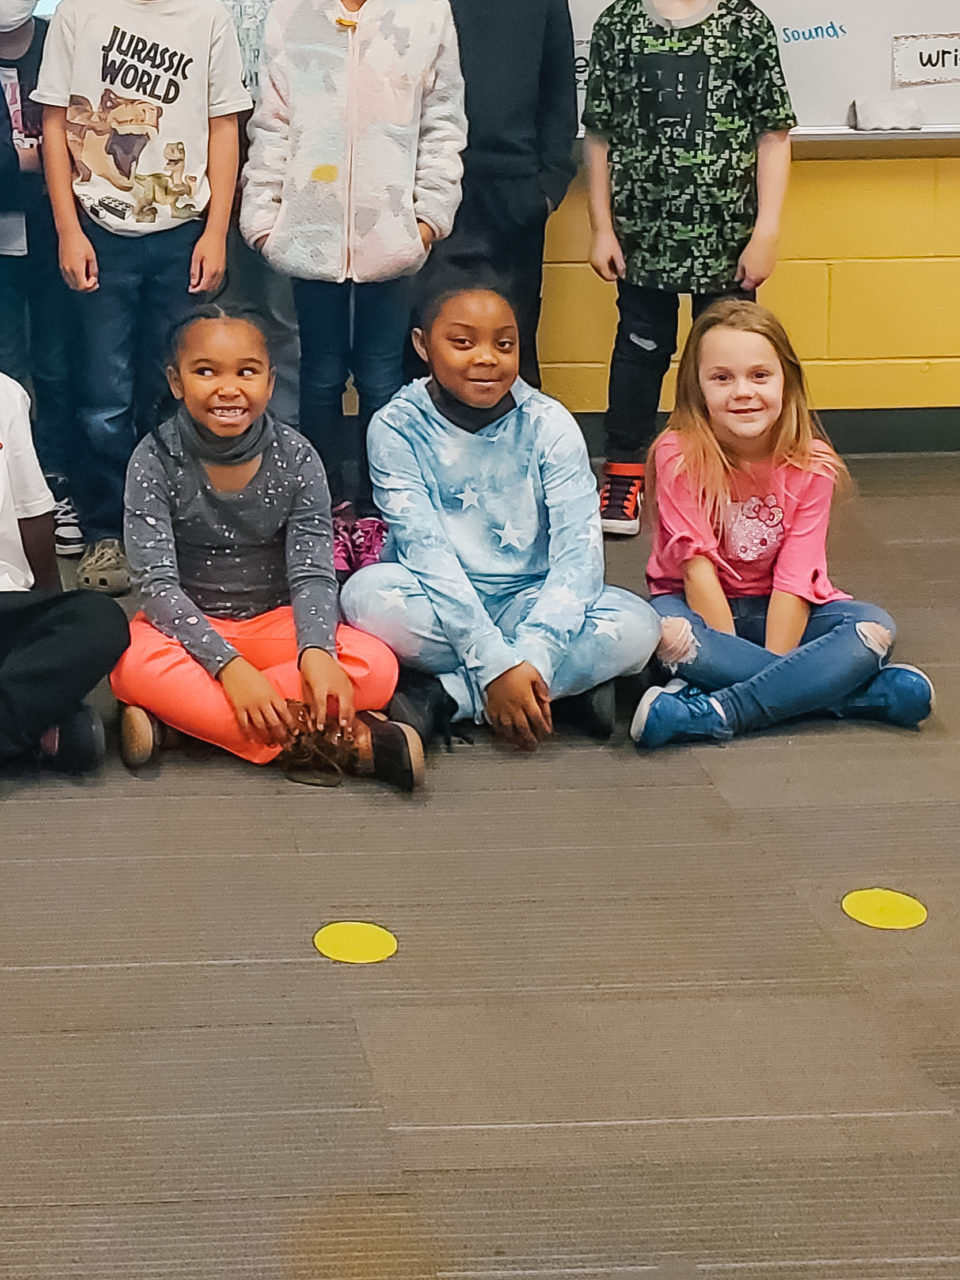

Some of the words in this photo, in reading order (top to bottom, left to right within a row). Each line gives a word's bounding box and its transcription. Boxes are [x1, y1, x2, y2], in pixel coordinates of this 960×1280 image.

[782, 20, 847, 44] sounds
[101, 26, 194, 80] JURASSIC
[919, 48, 960, 68] wri
[100, 50, 180, 104] WORLD
